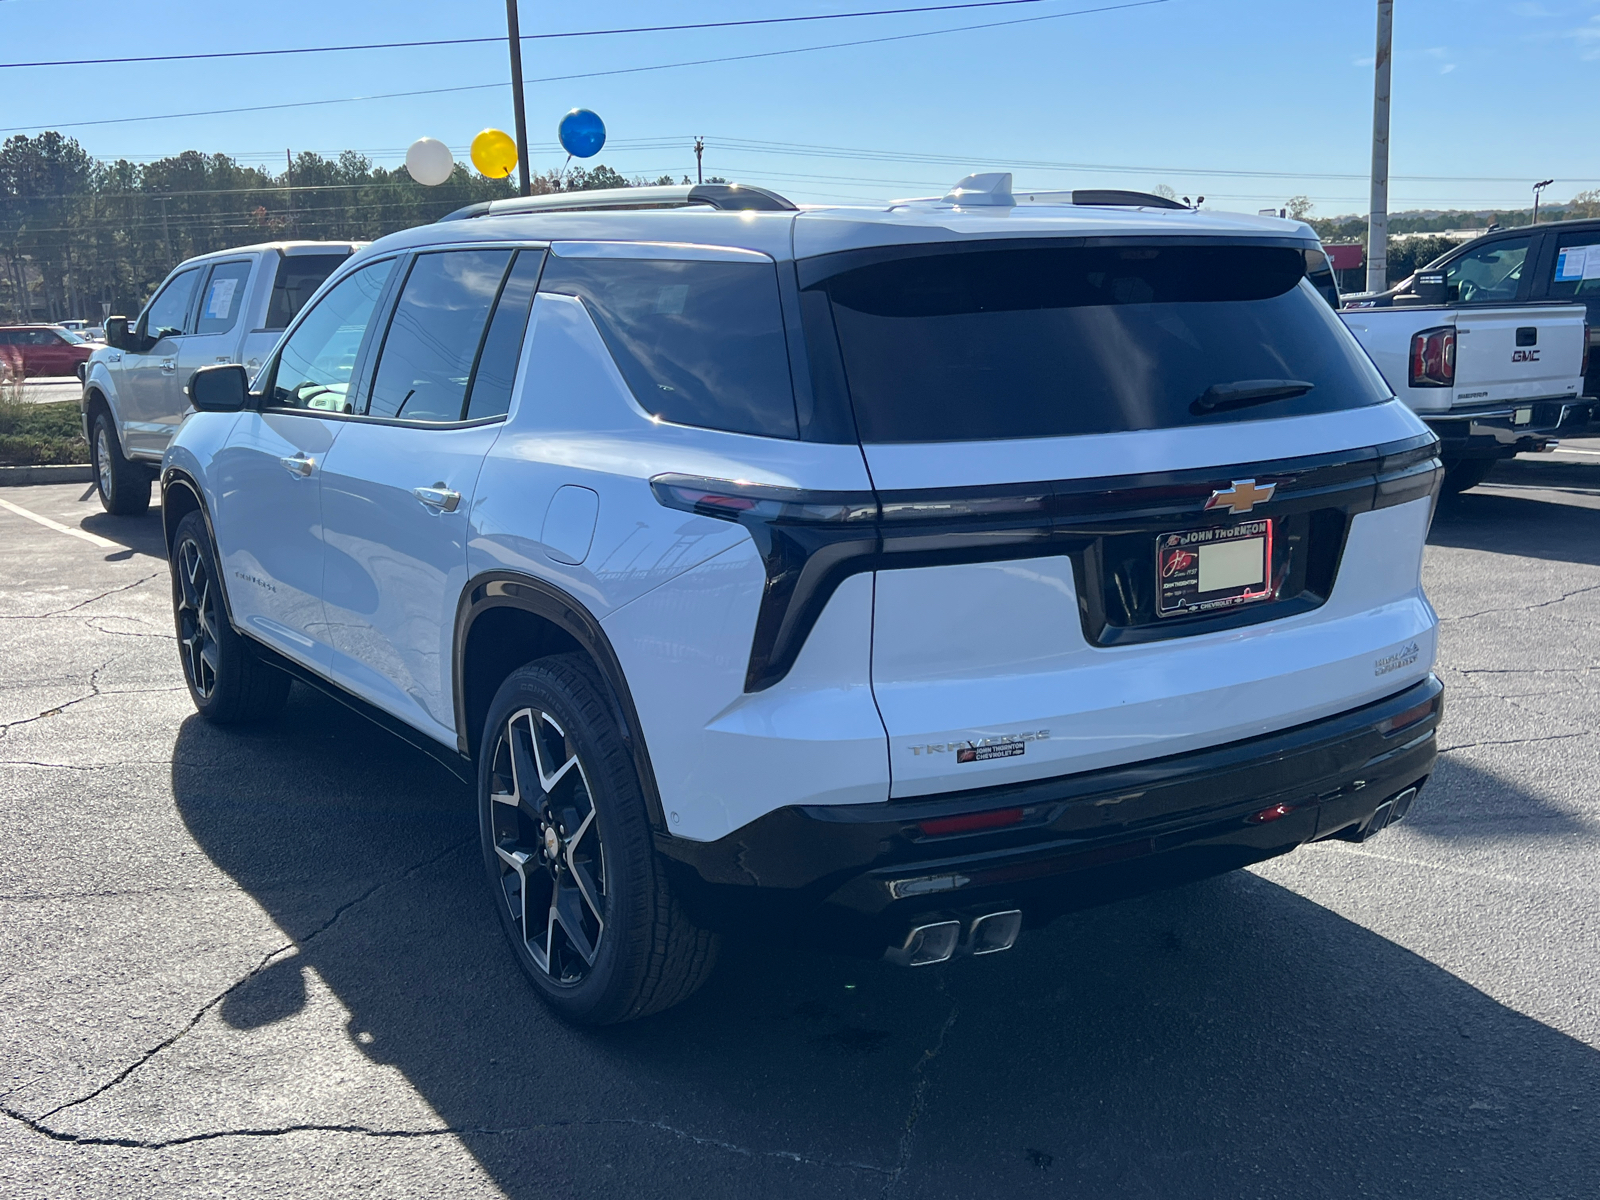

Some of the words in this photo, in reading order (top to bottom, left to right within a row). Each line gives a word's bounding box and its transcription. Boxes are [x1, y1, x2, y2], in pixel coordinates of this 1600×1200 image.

[1512, 350, 1540, 362] GMC
[1458, 391, 1488, 399] SIERRA
[1186, 529, 1213, 543] JOHN
[1215, 522, 1267, 539] THORNTON
[1200, 599, 1233, 610] CHEVROLET
[908, 729, 1050, 756] TRAVERSE
[976, 746, 992, 755] JOHN
[992, 742, 1024, 751] THORNTON
[976, 750, 1012, 760] CHEVROLET
